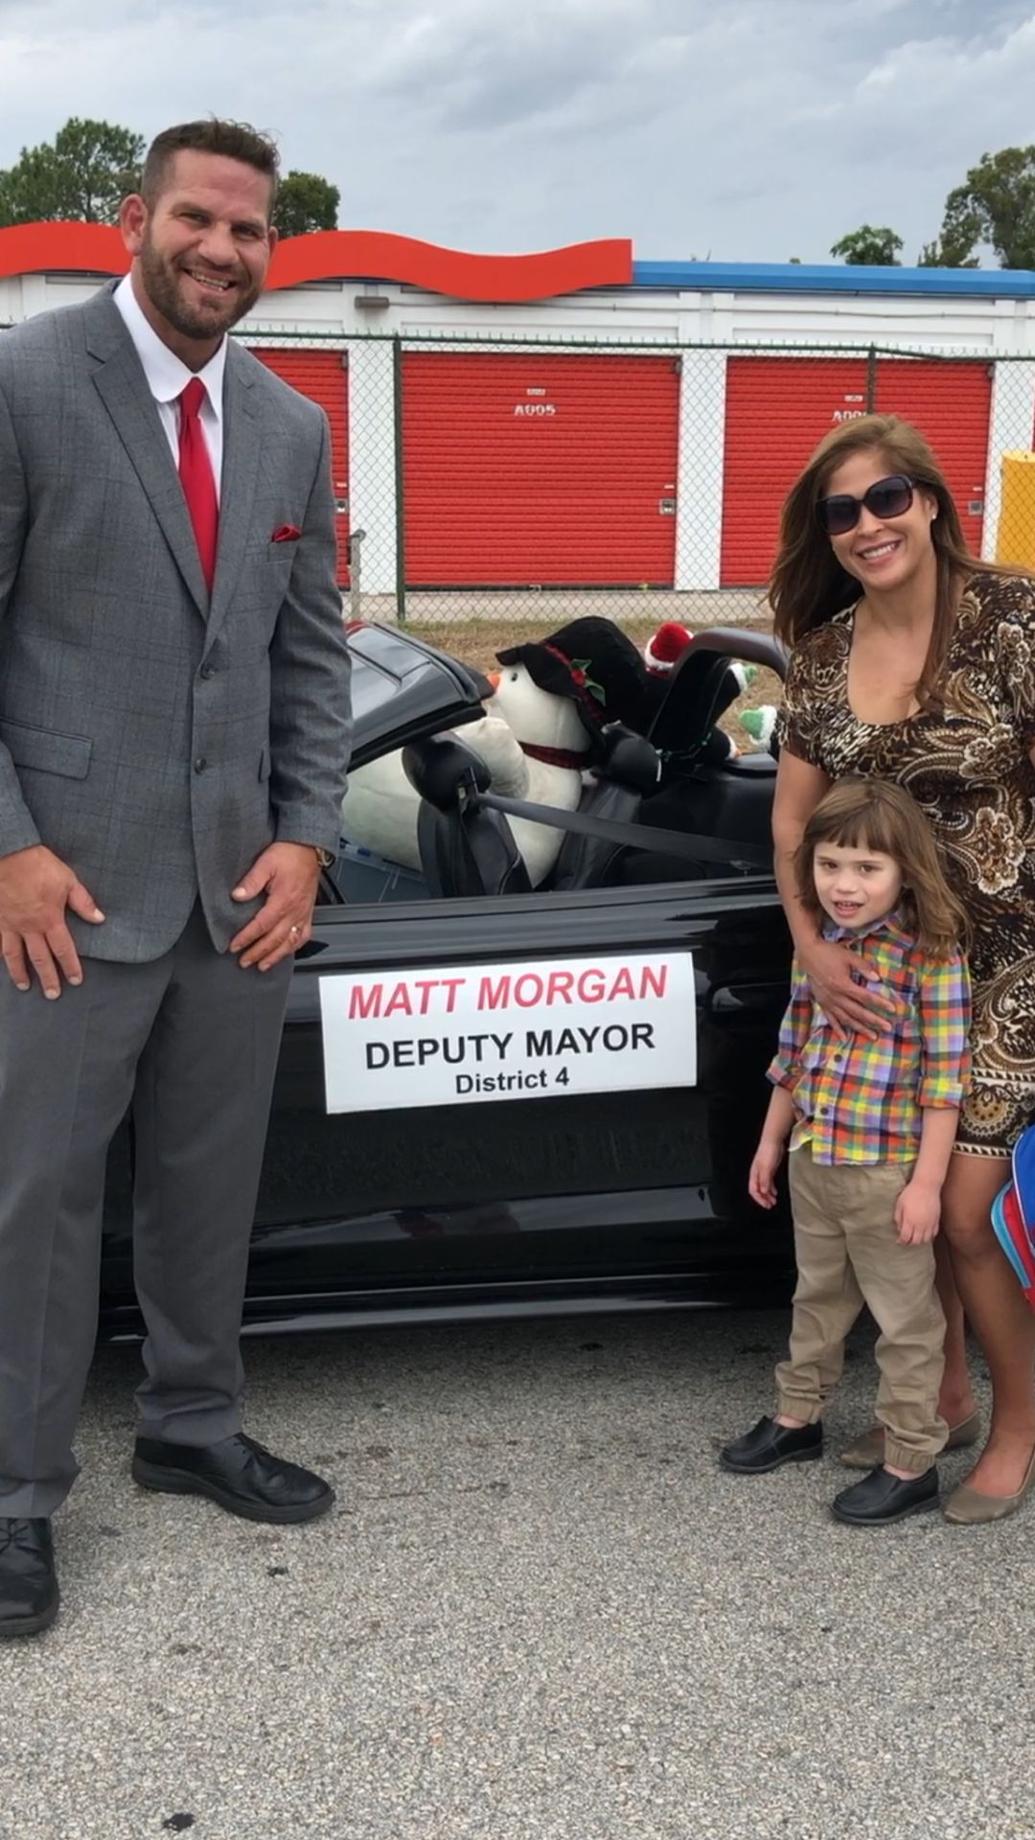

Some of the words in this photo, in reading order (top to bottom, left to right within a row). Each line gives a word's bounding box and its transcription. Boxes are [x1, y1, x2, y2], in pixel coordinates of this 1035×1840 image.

[514, 404, 556, 416] A005
[348, 978, 465, 1020] MATT
[477, 965, 667, 1011] MORGAN
[366, 1032, 513, 1069] DEPUTY
[526, 1023, 655, 1058] MAYOR
[456, 1069, 547, 1094] District
[555, 1067, 570, 1086] 4
